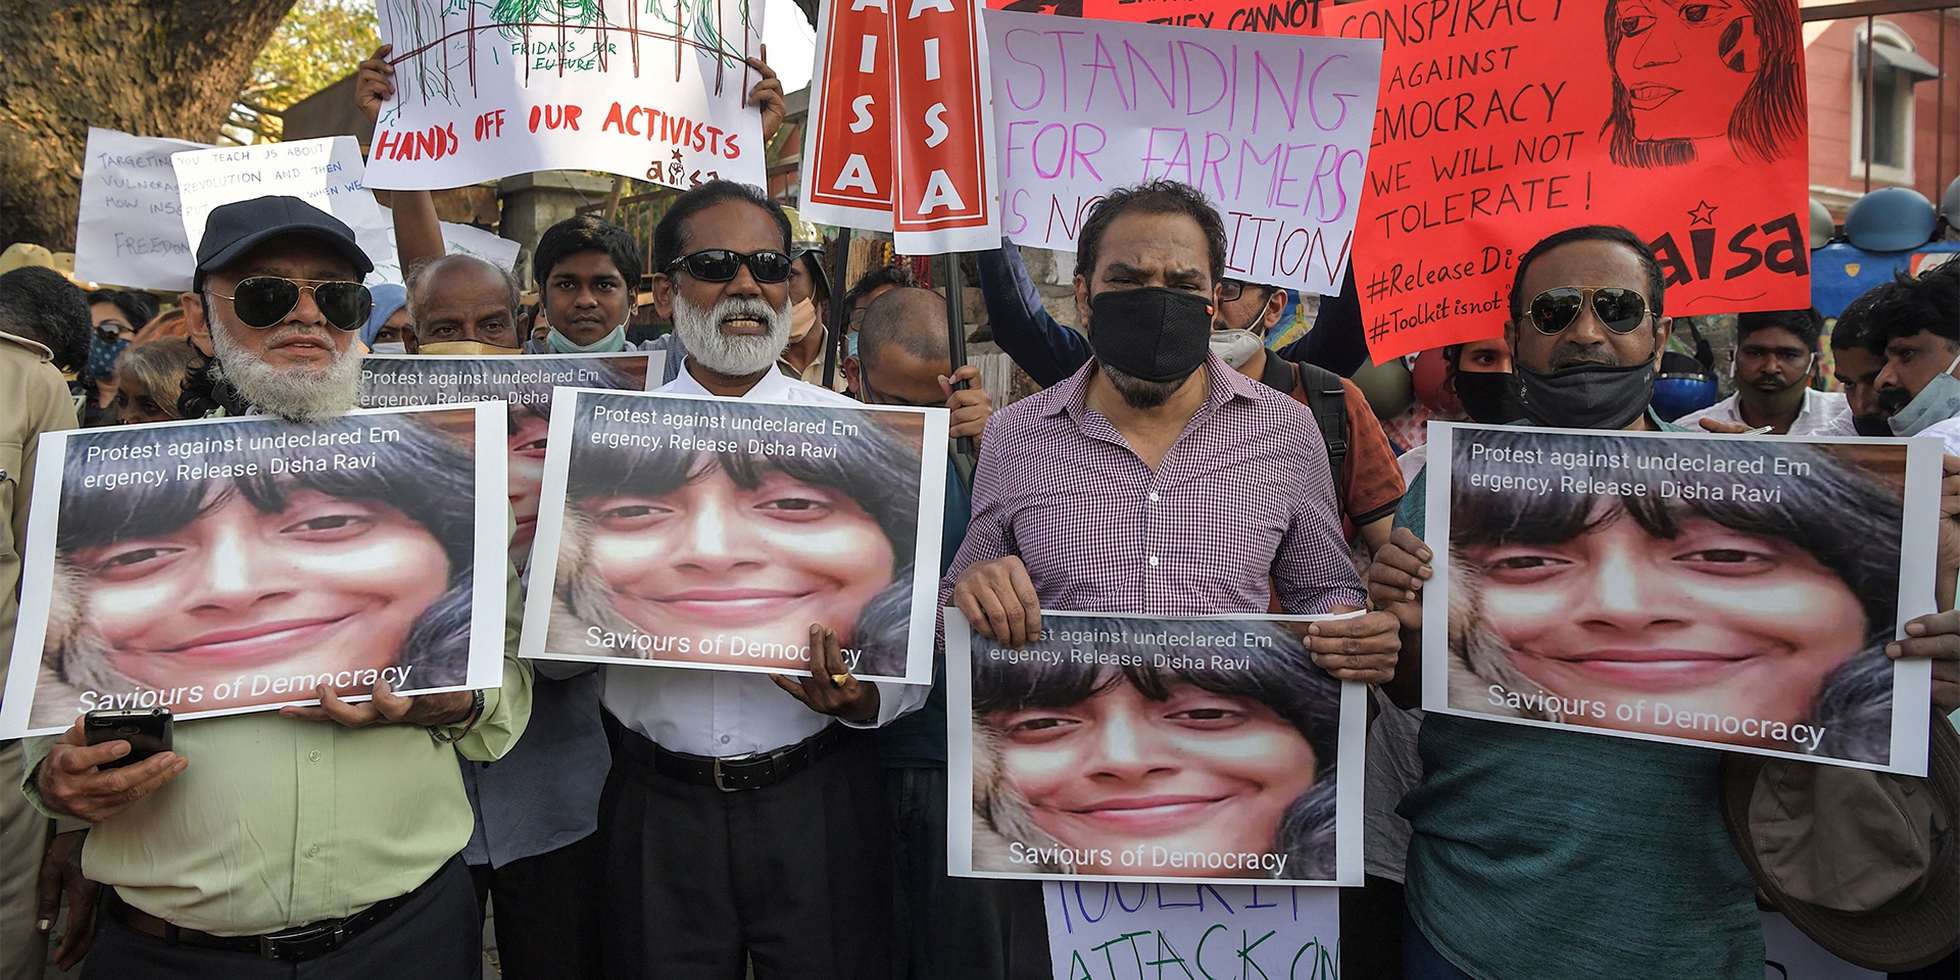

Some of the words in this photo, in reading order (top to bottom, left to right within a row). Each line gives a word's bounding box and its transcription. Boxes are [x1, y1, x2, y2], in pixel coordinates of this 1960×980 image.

[1228, 1, 1319, 33] CANNOT
[511, 40, 576, 56] FRIDAYS
[1006, 27, 1359, 134] STANDING
[1388, 45, 1518, 93] AGAINST
[375, 121, 459, 162] HANDS
[474, 108, 506, 143] OFF
[528, 104, 582, 134] OUR
[601, 101, 741, 159] ACTIVISTS
[212, 151, 250, 163] TEACH
[286, 143, 324, 157] ABOUT
[1371, 161, 1411, 197] WE
[1431, 145, 1503, 182] WILL
[1515, 131, 1584, 165] NOT
[183, 171, 262, 194] REVOLUTION
[275, 168, 302, 181] AND
[311, 161, 342, 174] THEN
[1006, 120, 1107, 183] FOR
[1141, 127, 1364, 223] FARMERS
[307, 187, 339, 199] WHEN
[344, 180, 363, 193] WE
[1376, 175, 1570, 238] TOLERATE
[1000, 188, 1031, 235] IS
[1646, 200, 1809, 289] aisa
[361, 370, 423, 386] Protest
[428, 370, 488, 389] against
[493, 369, 573, 385] undeclared
[578, 369, 599, 382] Em
[508, 391, 549, 405] Disha
[594, 406, 658, 426] Protest
[662, 412, 726, 431] against
[732, 415, 826, 435] undeclared
[832, 421, 859, 437] Em
[87, 441, 161, 462] Protest
[167, 437, 242, 459] against
[249, 429, 361, 450] undeclared
[369, 427, 400, 443] Em
[591, 431, 664, 452] ergency.
[669, 435, 738, 454] Release
[748, 439, 795, 458] Disha
[801, 443, 838, 459] Ravi
[1471, 443, 1543, 464] Protest
[1550, 448, 1629, 472] against
[1637, 453, 1764, 475] undeclared
[1773, 457, 1811, 477] Em
[83, 467, 169, 490] ergency.
[176, 462, 258, 481] Release
[270, 455, 327, 474] Disha
[333, 452, 376, 470] Ravi
[1470, 473, 1553, 495] ergency.
[1561, 476, 1646, 497] Release
[1660, 480, 1724, 501] Disha
[1732, 484, 1781, 504] Ravi
[585, 626, 691, 653] Saviours
[699, 634, 724, 655] of
[1060, 629, 1128, 649] against
[1134, 630, 1236, 648] undeclared
[1244, 632, 1272, 648] Em
[990, 649, 1064, 666] ergency.
[1070, 650, 1142, 668] Release
[1154, 653, 1205, 670] Disha
[1211, 655, 1250, 671] Ravi
[77, 681, 203, 714] Saviours
[213, 674, 246, 700] of
[250, 664, 412, 697] Democracy
[1487, 684, 1606, 718] Saviours
[1616, 696, 1646, 723] of
[1654, 702, 1826, 751] Democracy
[1009, 842, 1112, 866] Saviours
[1120, 845, 1145, 867] of
[1152, 846, 1289, 876] Democracy
